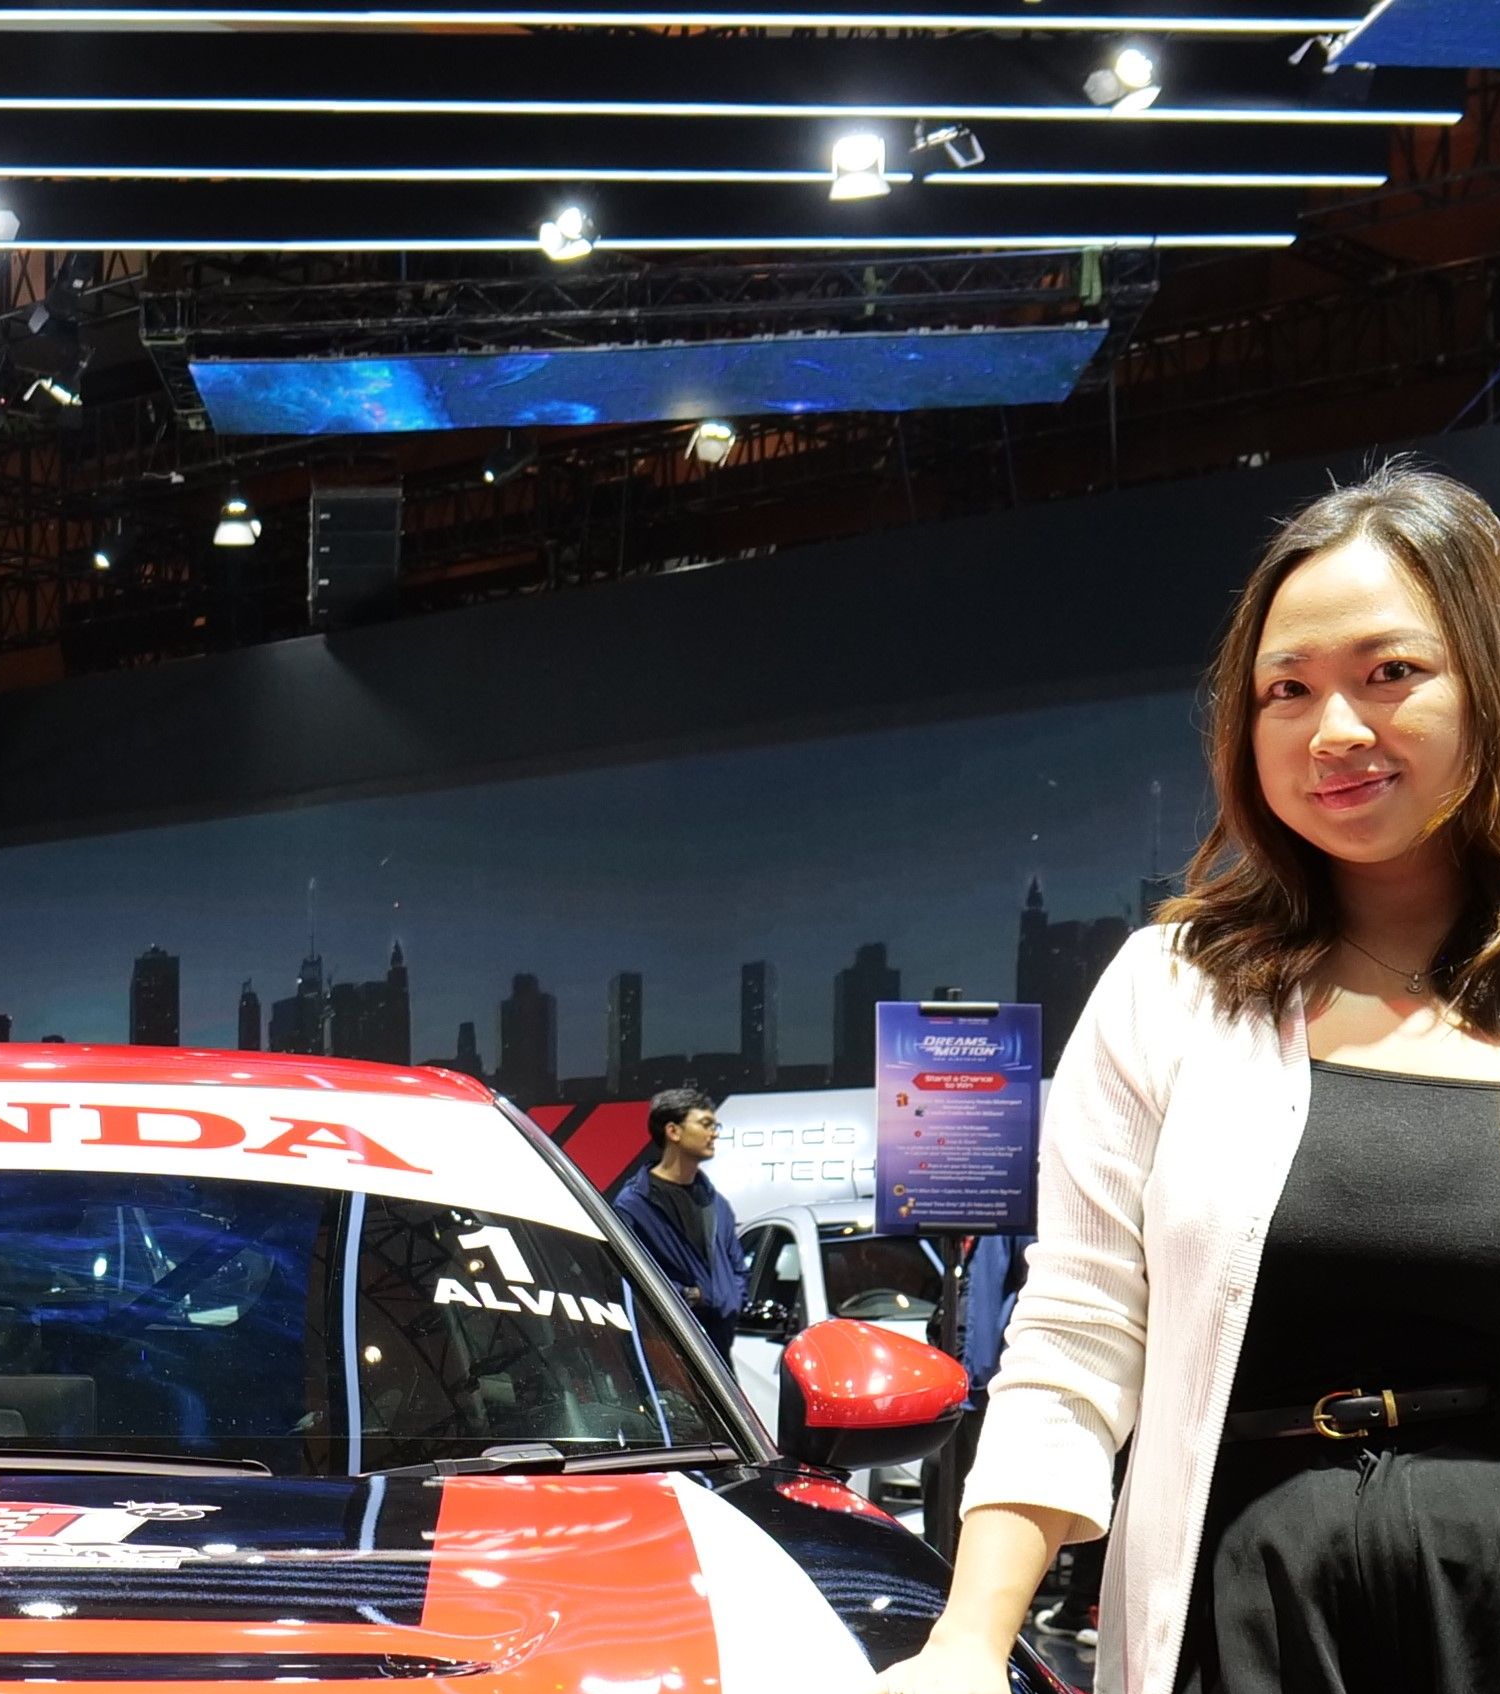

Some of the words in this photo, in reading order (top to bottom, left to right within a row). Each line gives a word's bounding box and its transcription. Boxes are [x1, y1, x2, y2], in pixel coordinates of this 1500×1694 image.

[922, 1035, 988, 1046] DREAMS
[933, 1045, 997, 1057] MOTION
[960, 1075, 994, 1083] Chance
[462, 1226, 536, 1284] 1
[433, 1276, 632, 1332] ALVIN
